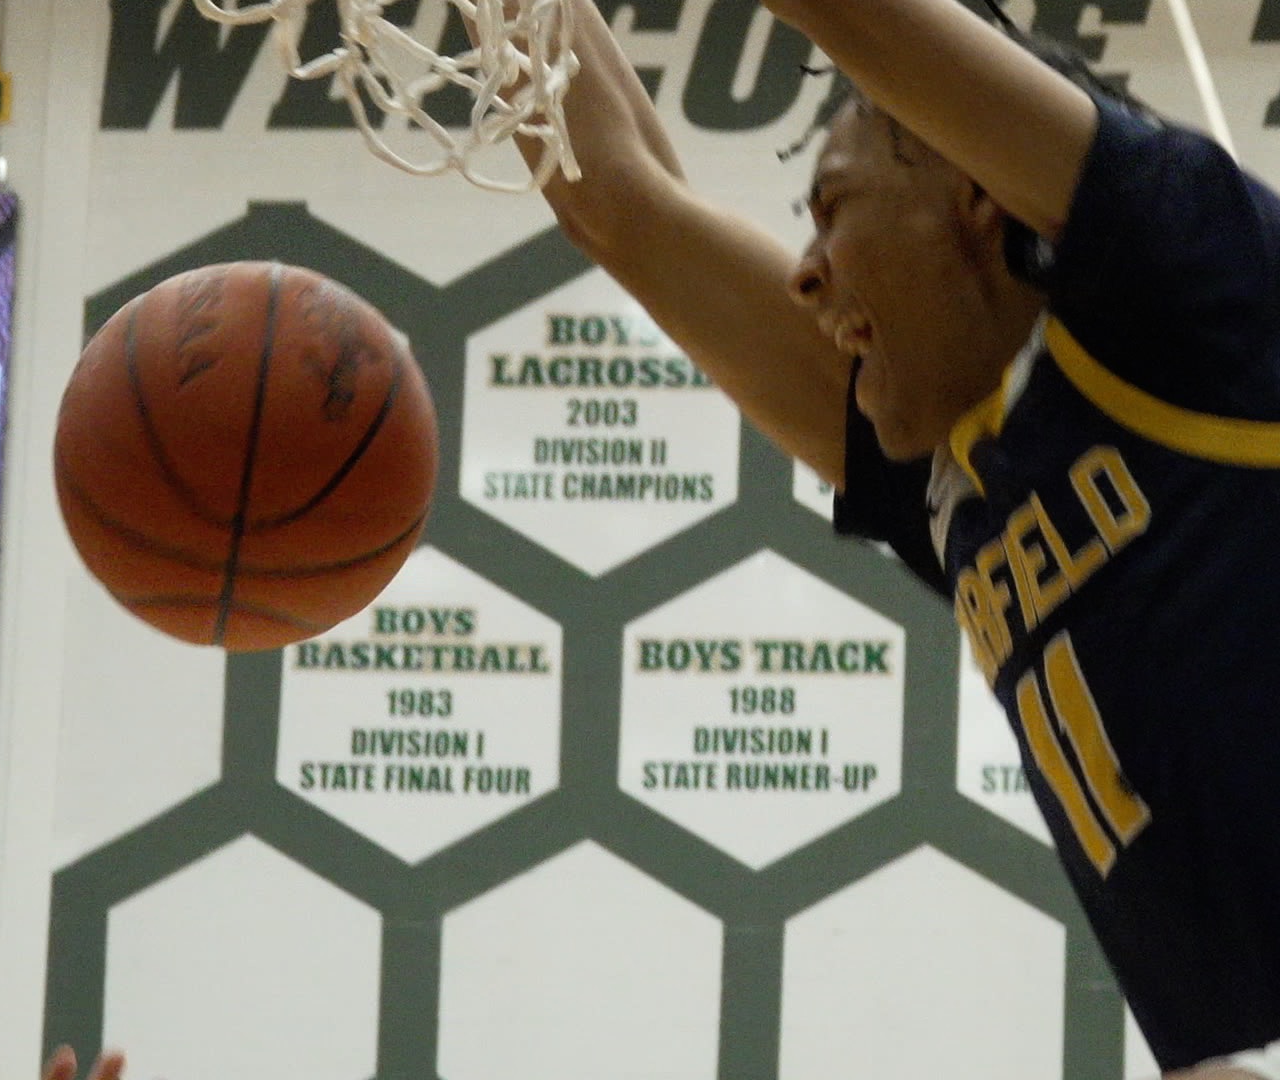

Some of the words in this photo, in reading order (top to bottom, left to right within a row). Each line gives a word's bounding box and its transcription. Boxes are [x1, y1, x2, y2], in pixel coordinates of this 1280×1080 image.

[546, 315, 658, 347] BOY
[567, 398, 638, 427] 2003
[535, 437, 642, 466] DIVISION
[651, 439, 666, 465] II
[484, 471, 553, 500] STATE
[563, 473, 713, 502] CHAMPIONS
[375, 607, 476, 635] BOYS
[297, 641, 550, 673] BASKETBALL
[639, 639, 740, 672] BOYS
[754, 641, 889, 673] TRACK
[387, 689, 453, 717] 1983
[729, 687, 796, 715] 1988
[351, 729, 467, 758] DIVISION
[476, 731, 485, 759] I
[693, 727, 811, 755] DIVISION
[820, 728, 829, 755] I
[1017, 628, 1152, 880] 11
[300, 762, 373, 791] STATE
[384, 764, 455, 793] FINAL
[464, 766, 531, 794] FOUR
[642, 761, 716, 790] STATE
[726, 762, 878, 792] RUNNER-UP
